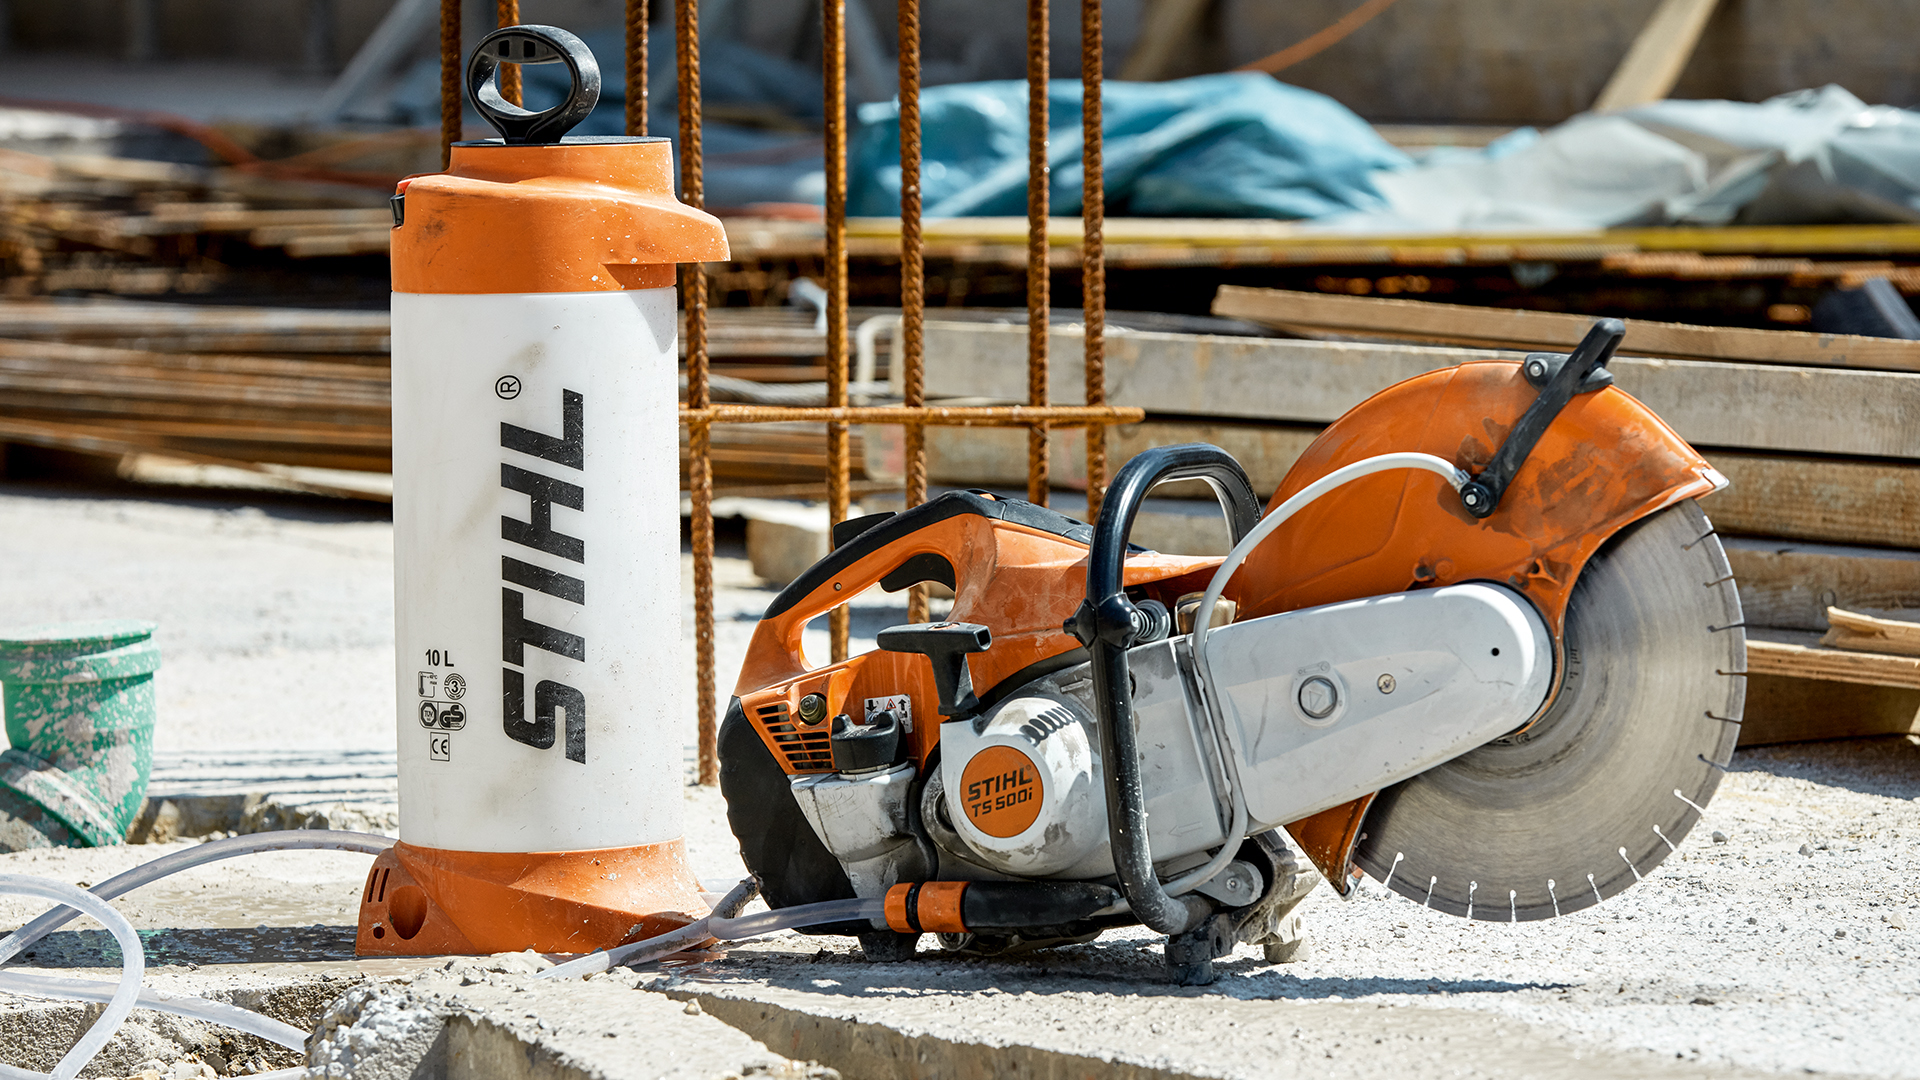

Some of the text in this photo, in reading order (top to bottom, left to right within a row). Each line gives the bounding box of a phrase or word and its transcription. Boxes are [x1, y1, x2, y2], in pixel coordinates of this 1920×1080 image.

[501, 388, 586, 765] STIHL
[425, 649, 454, 667] 10 L
[451, 680, 459, 693] 3
[432, 738, 448, 755] CE
[968, 767, 1033, 802] STIHL
[972, 786, 1032, 817] TS 500i
